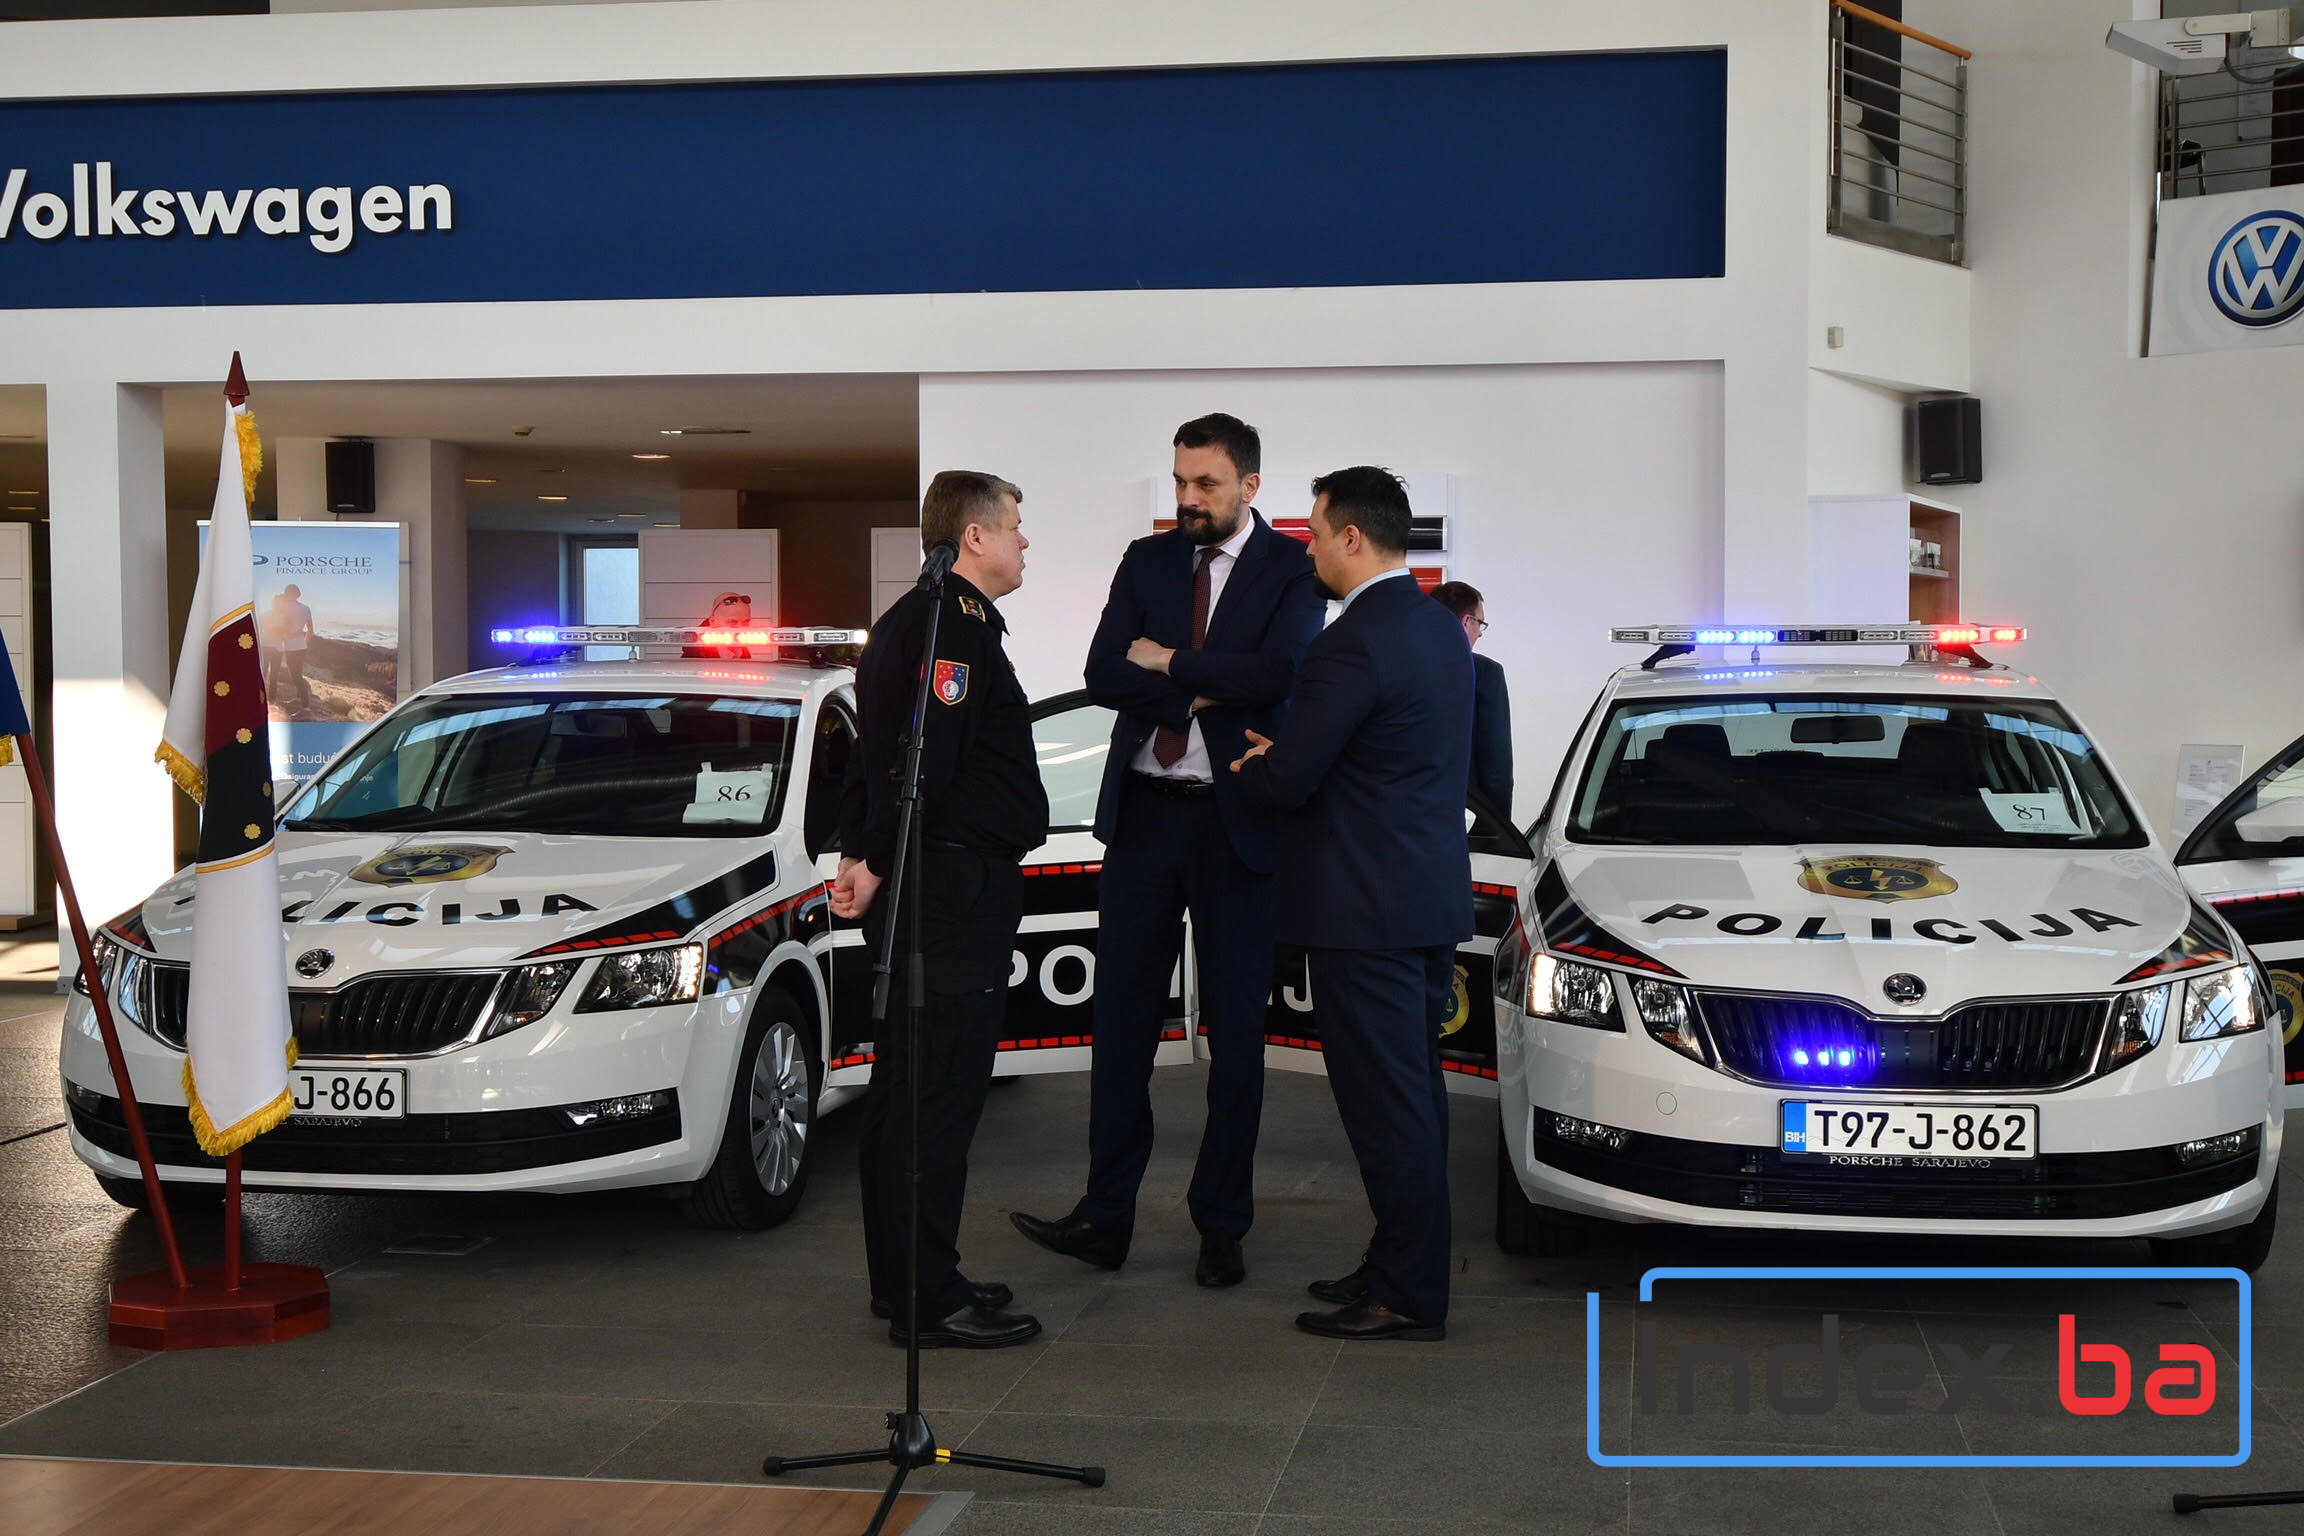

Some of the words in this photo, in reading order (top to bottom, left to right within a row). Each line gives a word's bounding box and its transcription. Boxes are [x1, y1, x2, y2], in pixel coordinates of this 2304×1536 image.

[276, 556, 372, 567] PORSCHE
[276, 567, 327, 575] FINANCE
[331, 567, 372, 575] GROUP
[717, 784, 751, 801] 86
[2013, 804, 2045, 820] 87
[175, 893, 599, 926] LICIJA
[1642, 903, 2142, 945] POLICIJA
[294, 1076, 396, 1111] J-866
[294, 1117, 362, 1127] SARAJEVO
[1784, 1131, 1806, 1143] BIH
[1814, 1110, 2027, 1151] T97-J-862
[1830, 1155, 1904, 1167] PORSCHE
[1912, 1157, 1991, 1169] SARAJEVO
